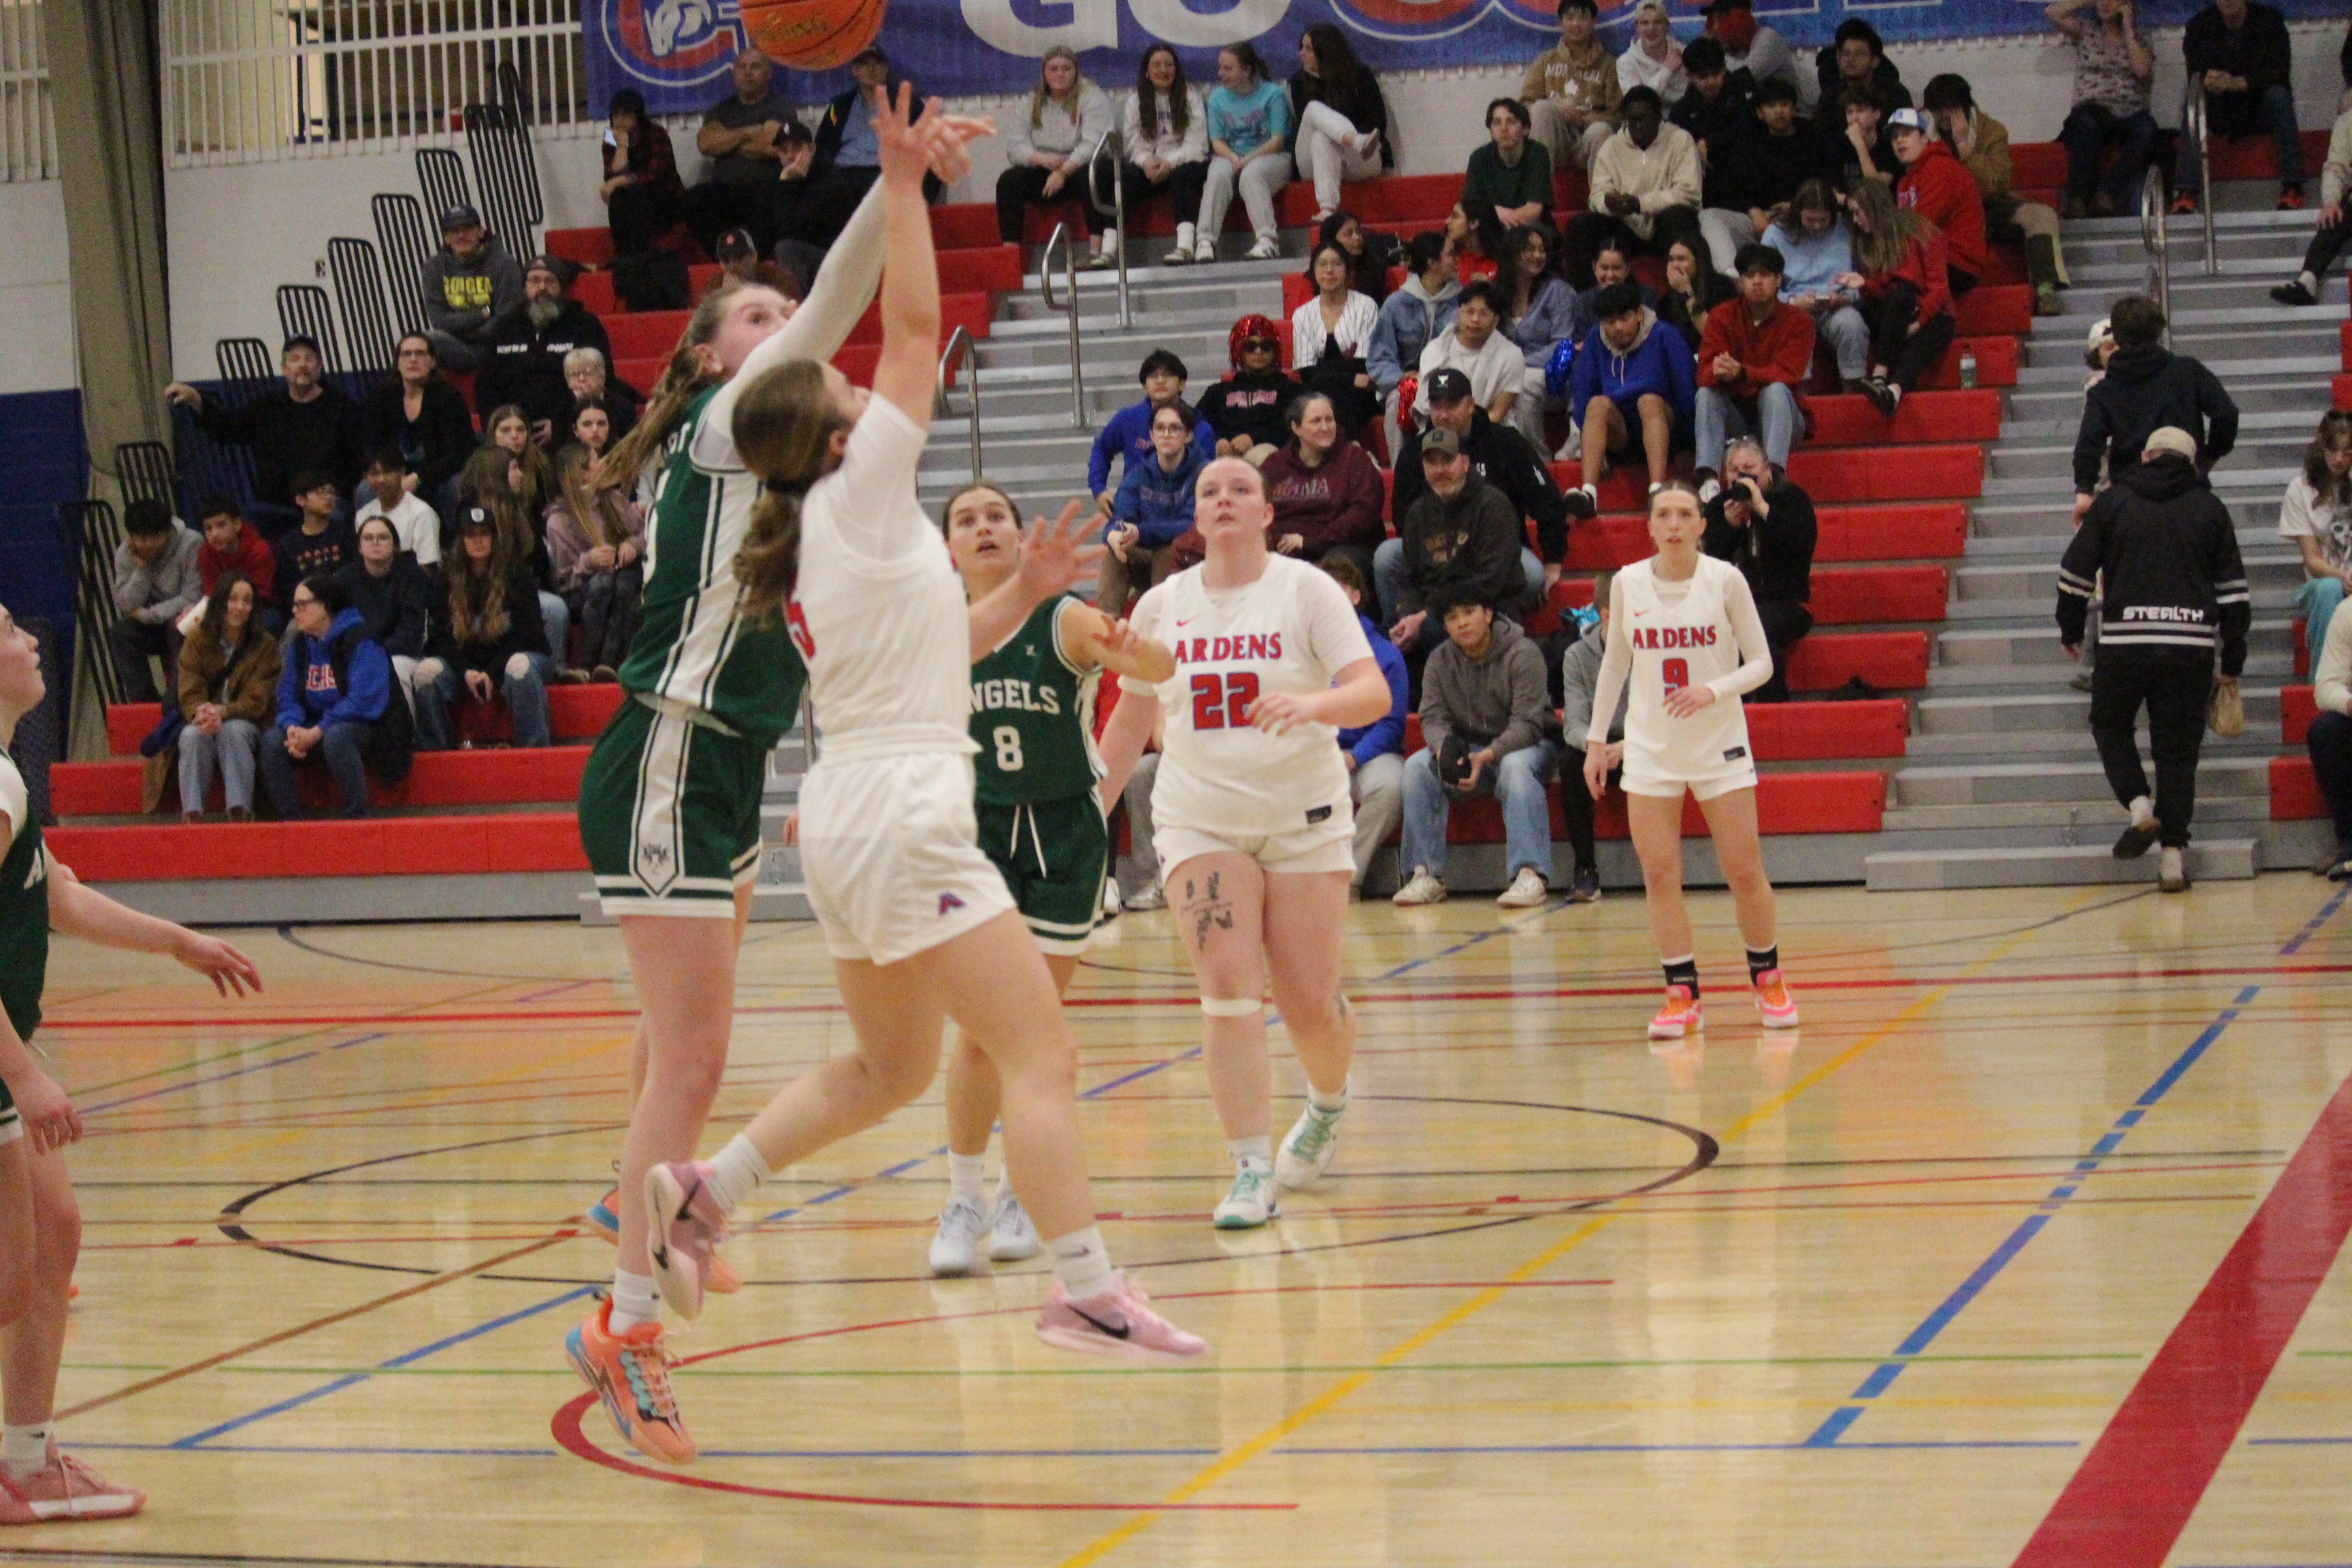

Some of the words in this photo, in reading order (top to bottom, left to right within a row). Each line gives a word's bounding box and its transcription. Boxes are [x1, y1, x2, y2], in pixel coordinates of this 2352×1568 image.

[2123, 605, 2204, 622] STEALTH
[1175, 632, 1282, 664] ARDENS
[1633, 625, 1716, 649] ARDENS
[1662, 657, 1689, 698] 9
[971, 679, 1061, 715] NGELS
[1190, 671, 1259, 730] 22
[993, 725, 1024, 772] 8
